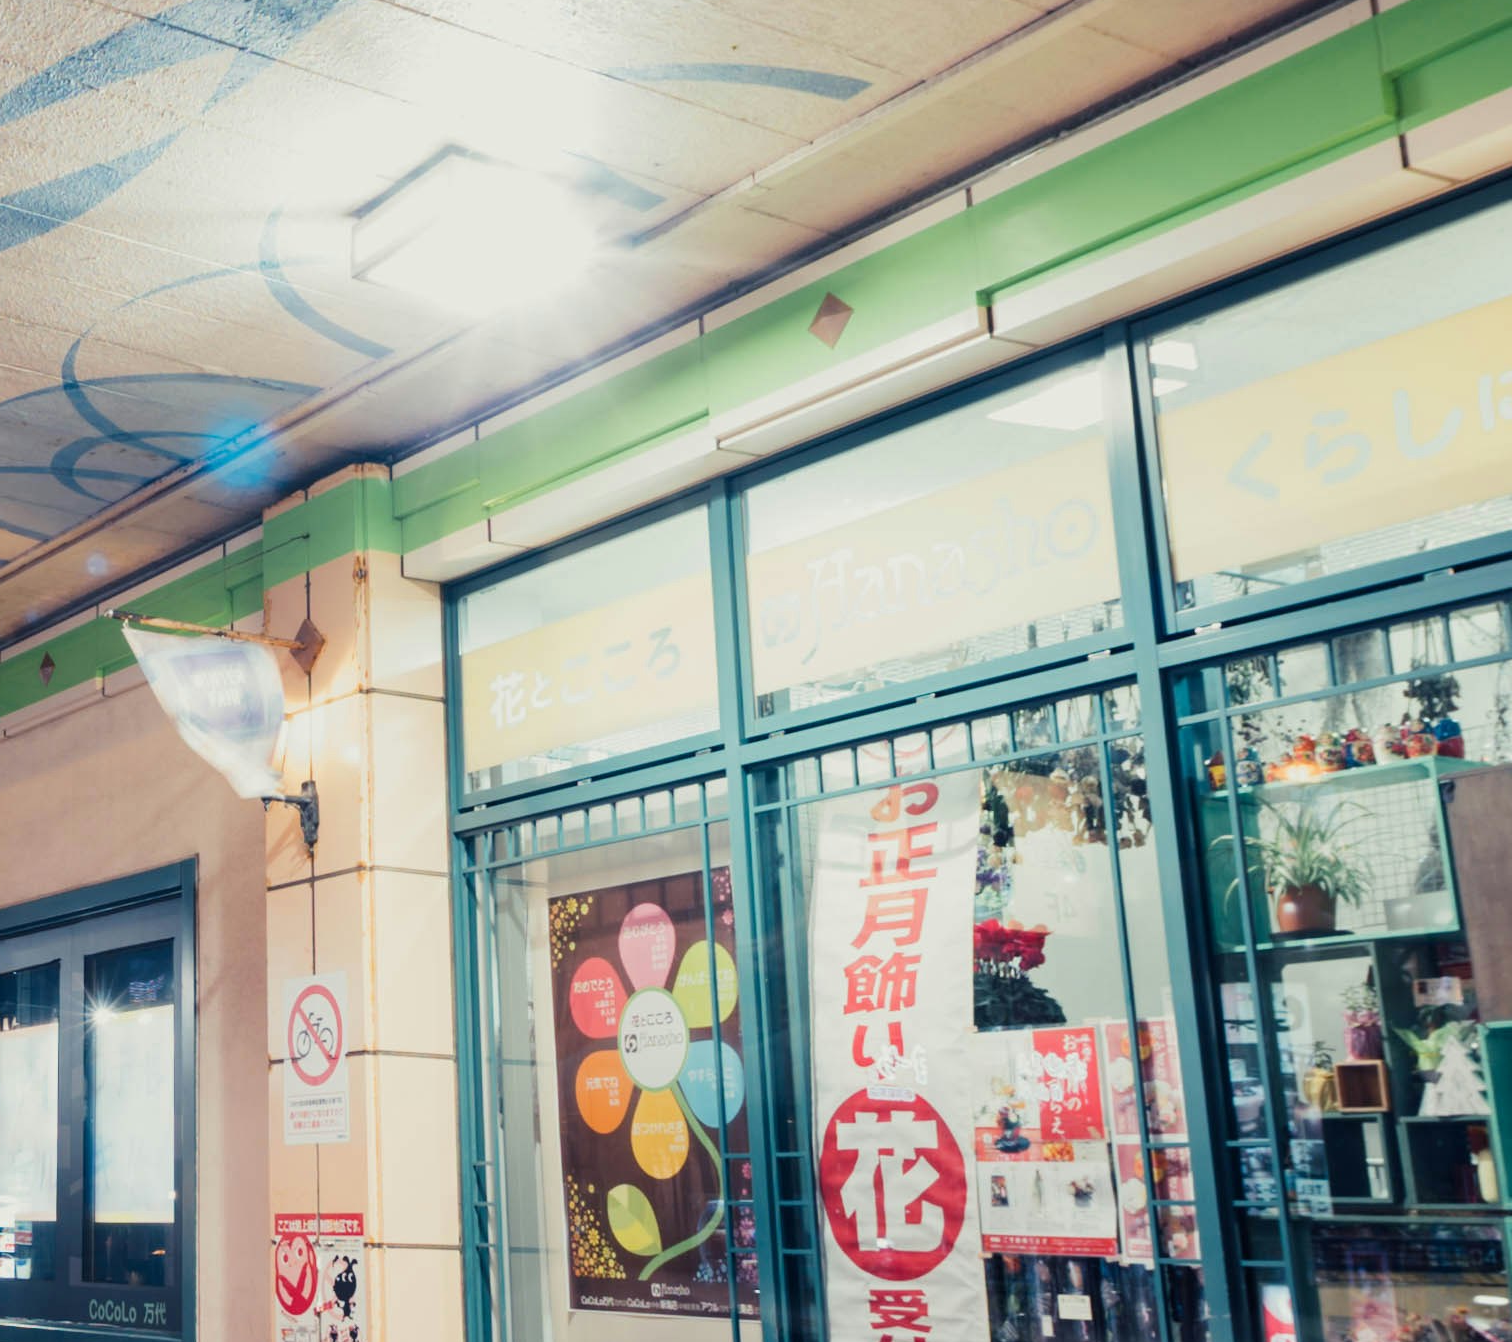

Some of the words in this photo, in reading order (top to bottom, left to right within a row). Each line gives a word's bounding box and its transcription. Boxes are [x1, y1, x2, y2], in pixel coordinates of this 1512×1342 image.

[490, 625, 680, 731] 花とこころ
[835, 1109, 945, 1253] 花
[89, 1299, 136, 1323] CoCoLo
[143, 1302, 166, 1325] 万代
